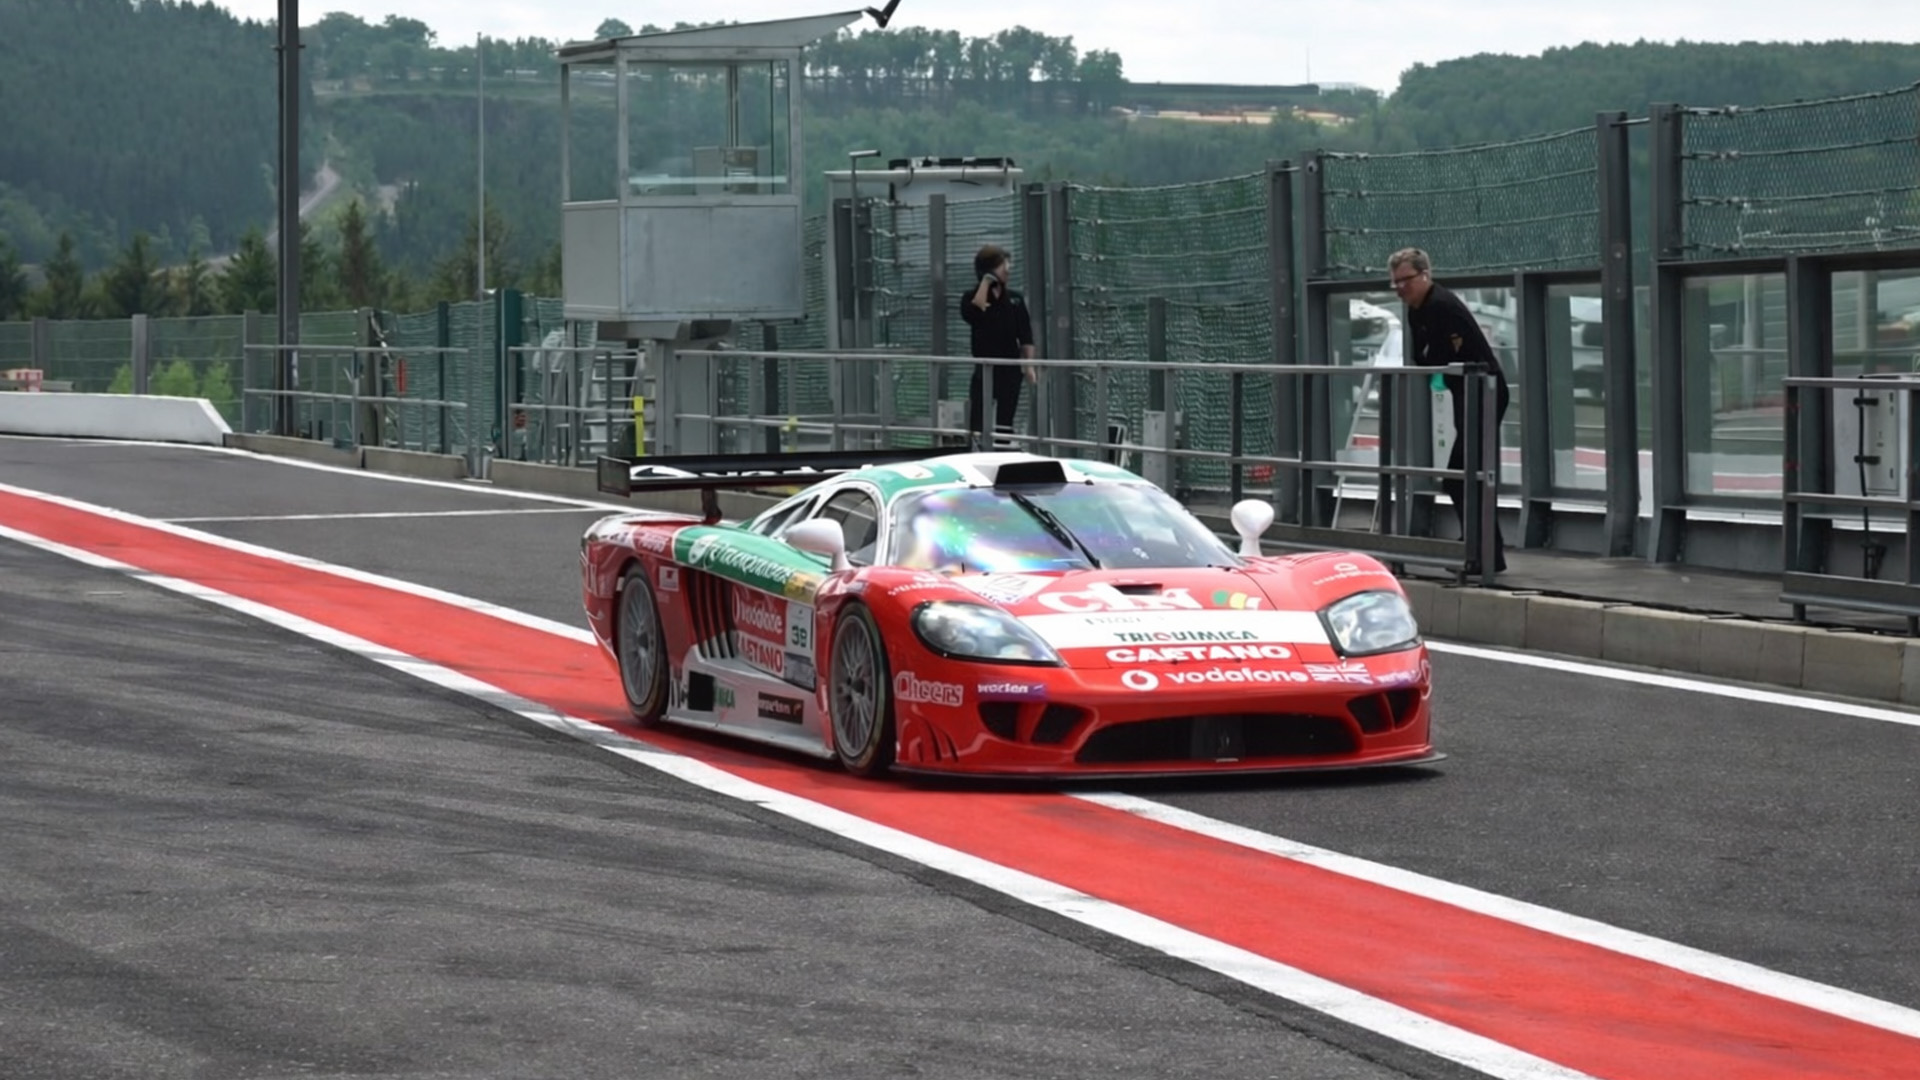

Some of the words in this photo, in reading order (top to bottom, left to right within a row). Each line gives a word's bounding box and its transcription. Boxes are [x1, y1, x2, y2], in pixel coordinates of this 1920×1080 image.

[1106, 645, 1292, 663] CAETANO
[1164, 667, 1310, 684] vodafone
[894, 671, 964, 706] Cheers
